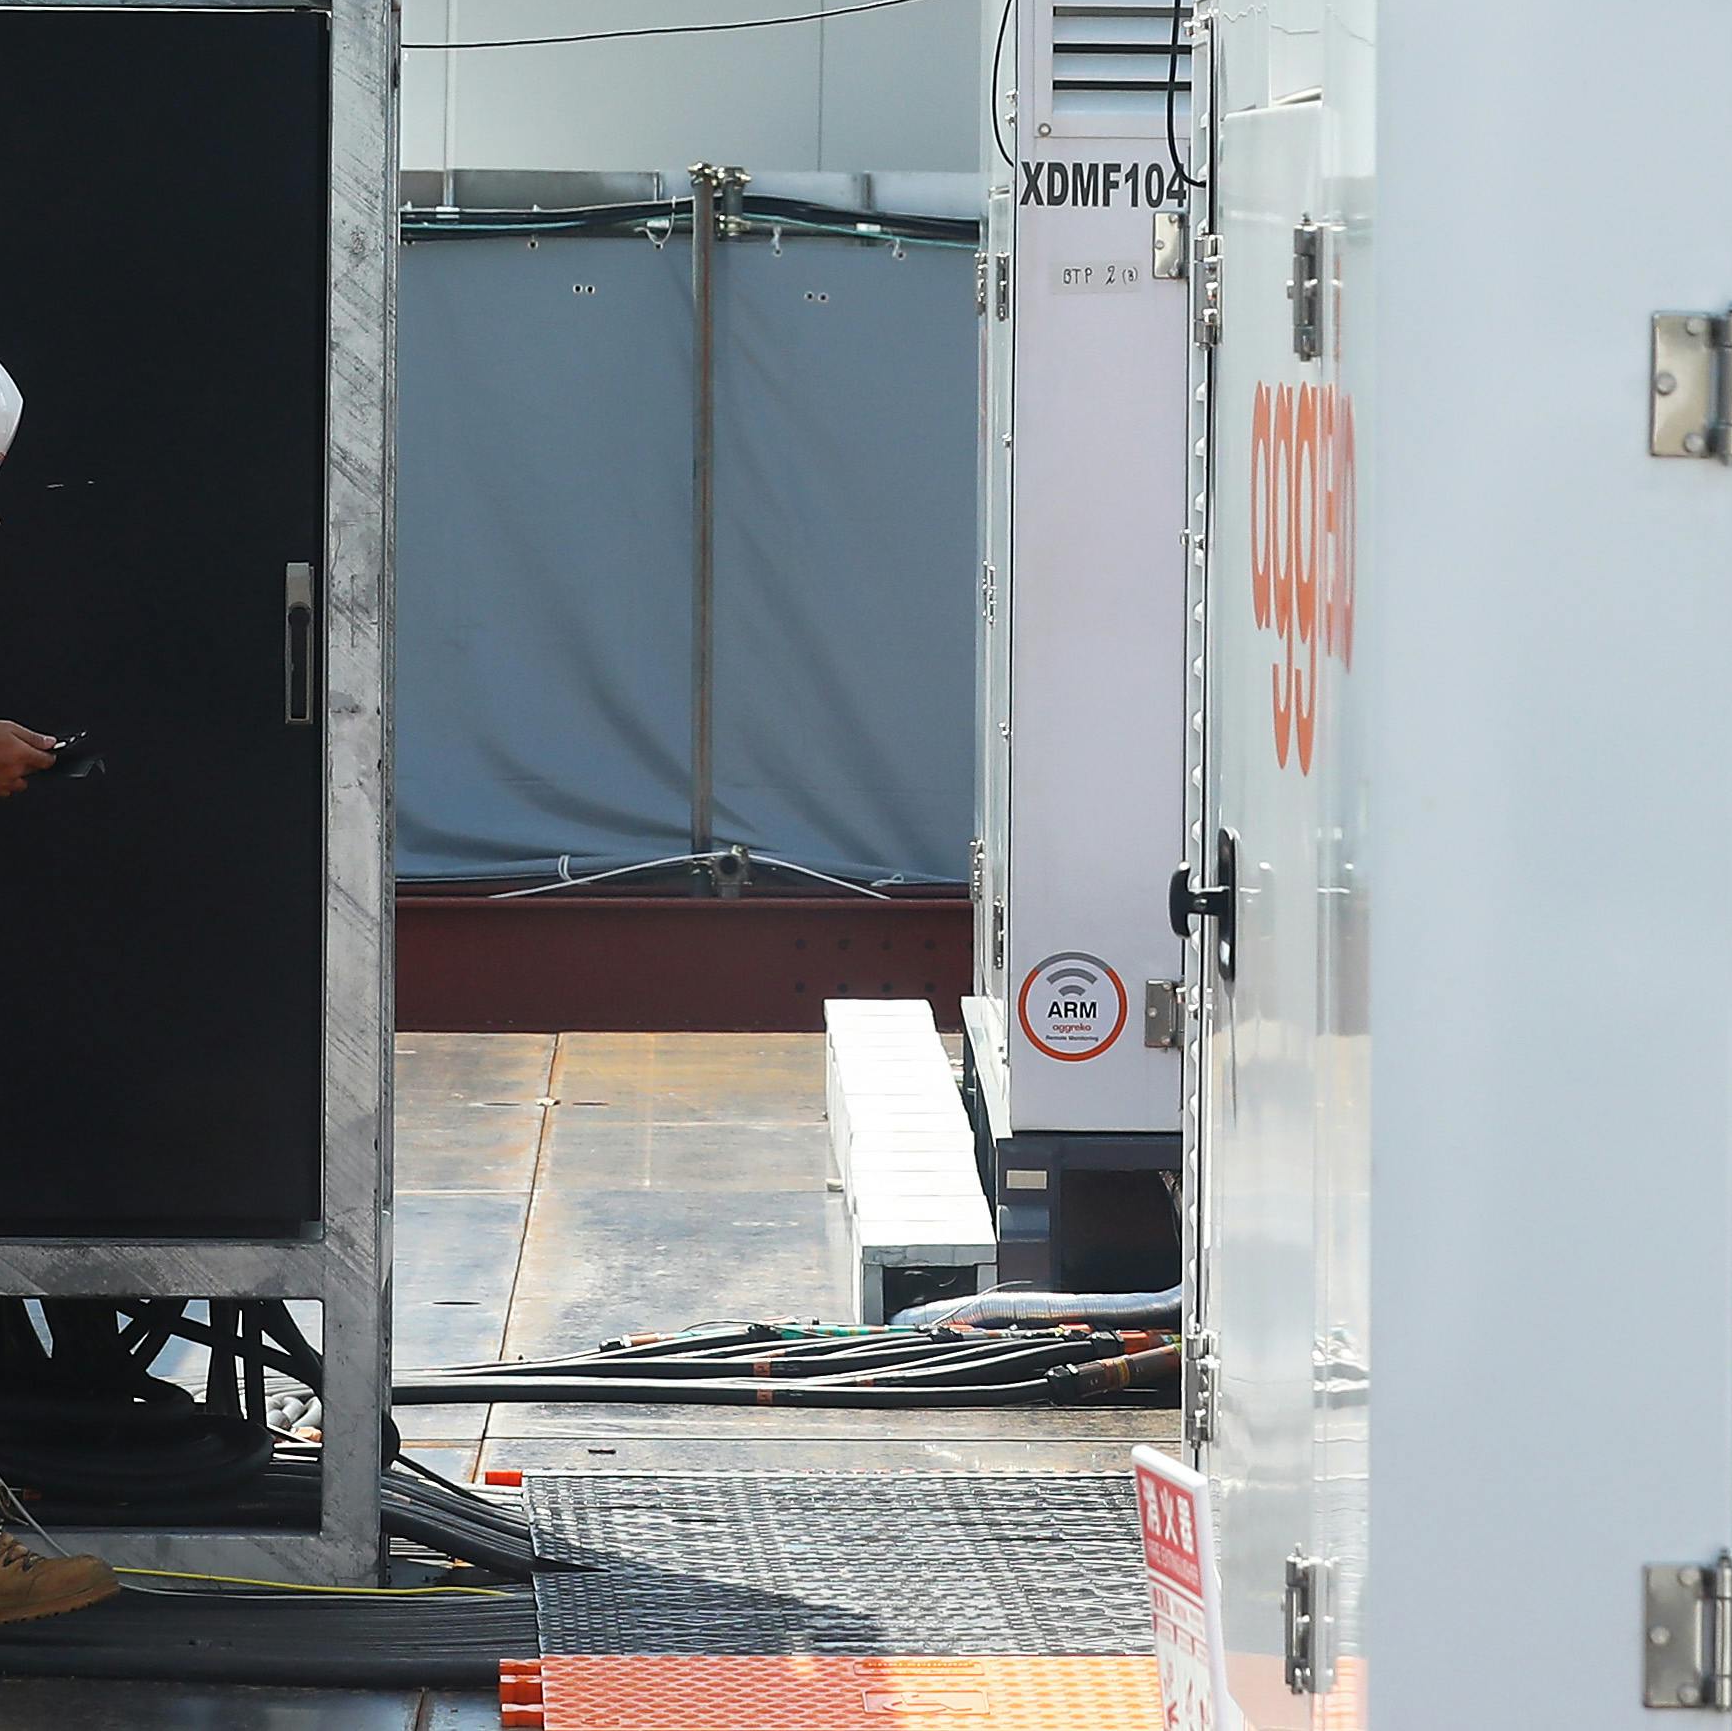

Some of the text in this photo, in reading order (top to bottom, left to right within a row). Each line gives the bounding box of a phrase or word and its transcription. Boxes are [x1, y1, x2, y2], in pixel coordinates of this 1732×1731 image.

[1020, 161, 1187, 208] XDMF104
[1063, 267, 1093, 284] BTP
[1106, 265, 1116, 285] 2
[1047, 1001, 1097, 1019] ARM
[1052, 1022, 1092, 1033] aggreko
